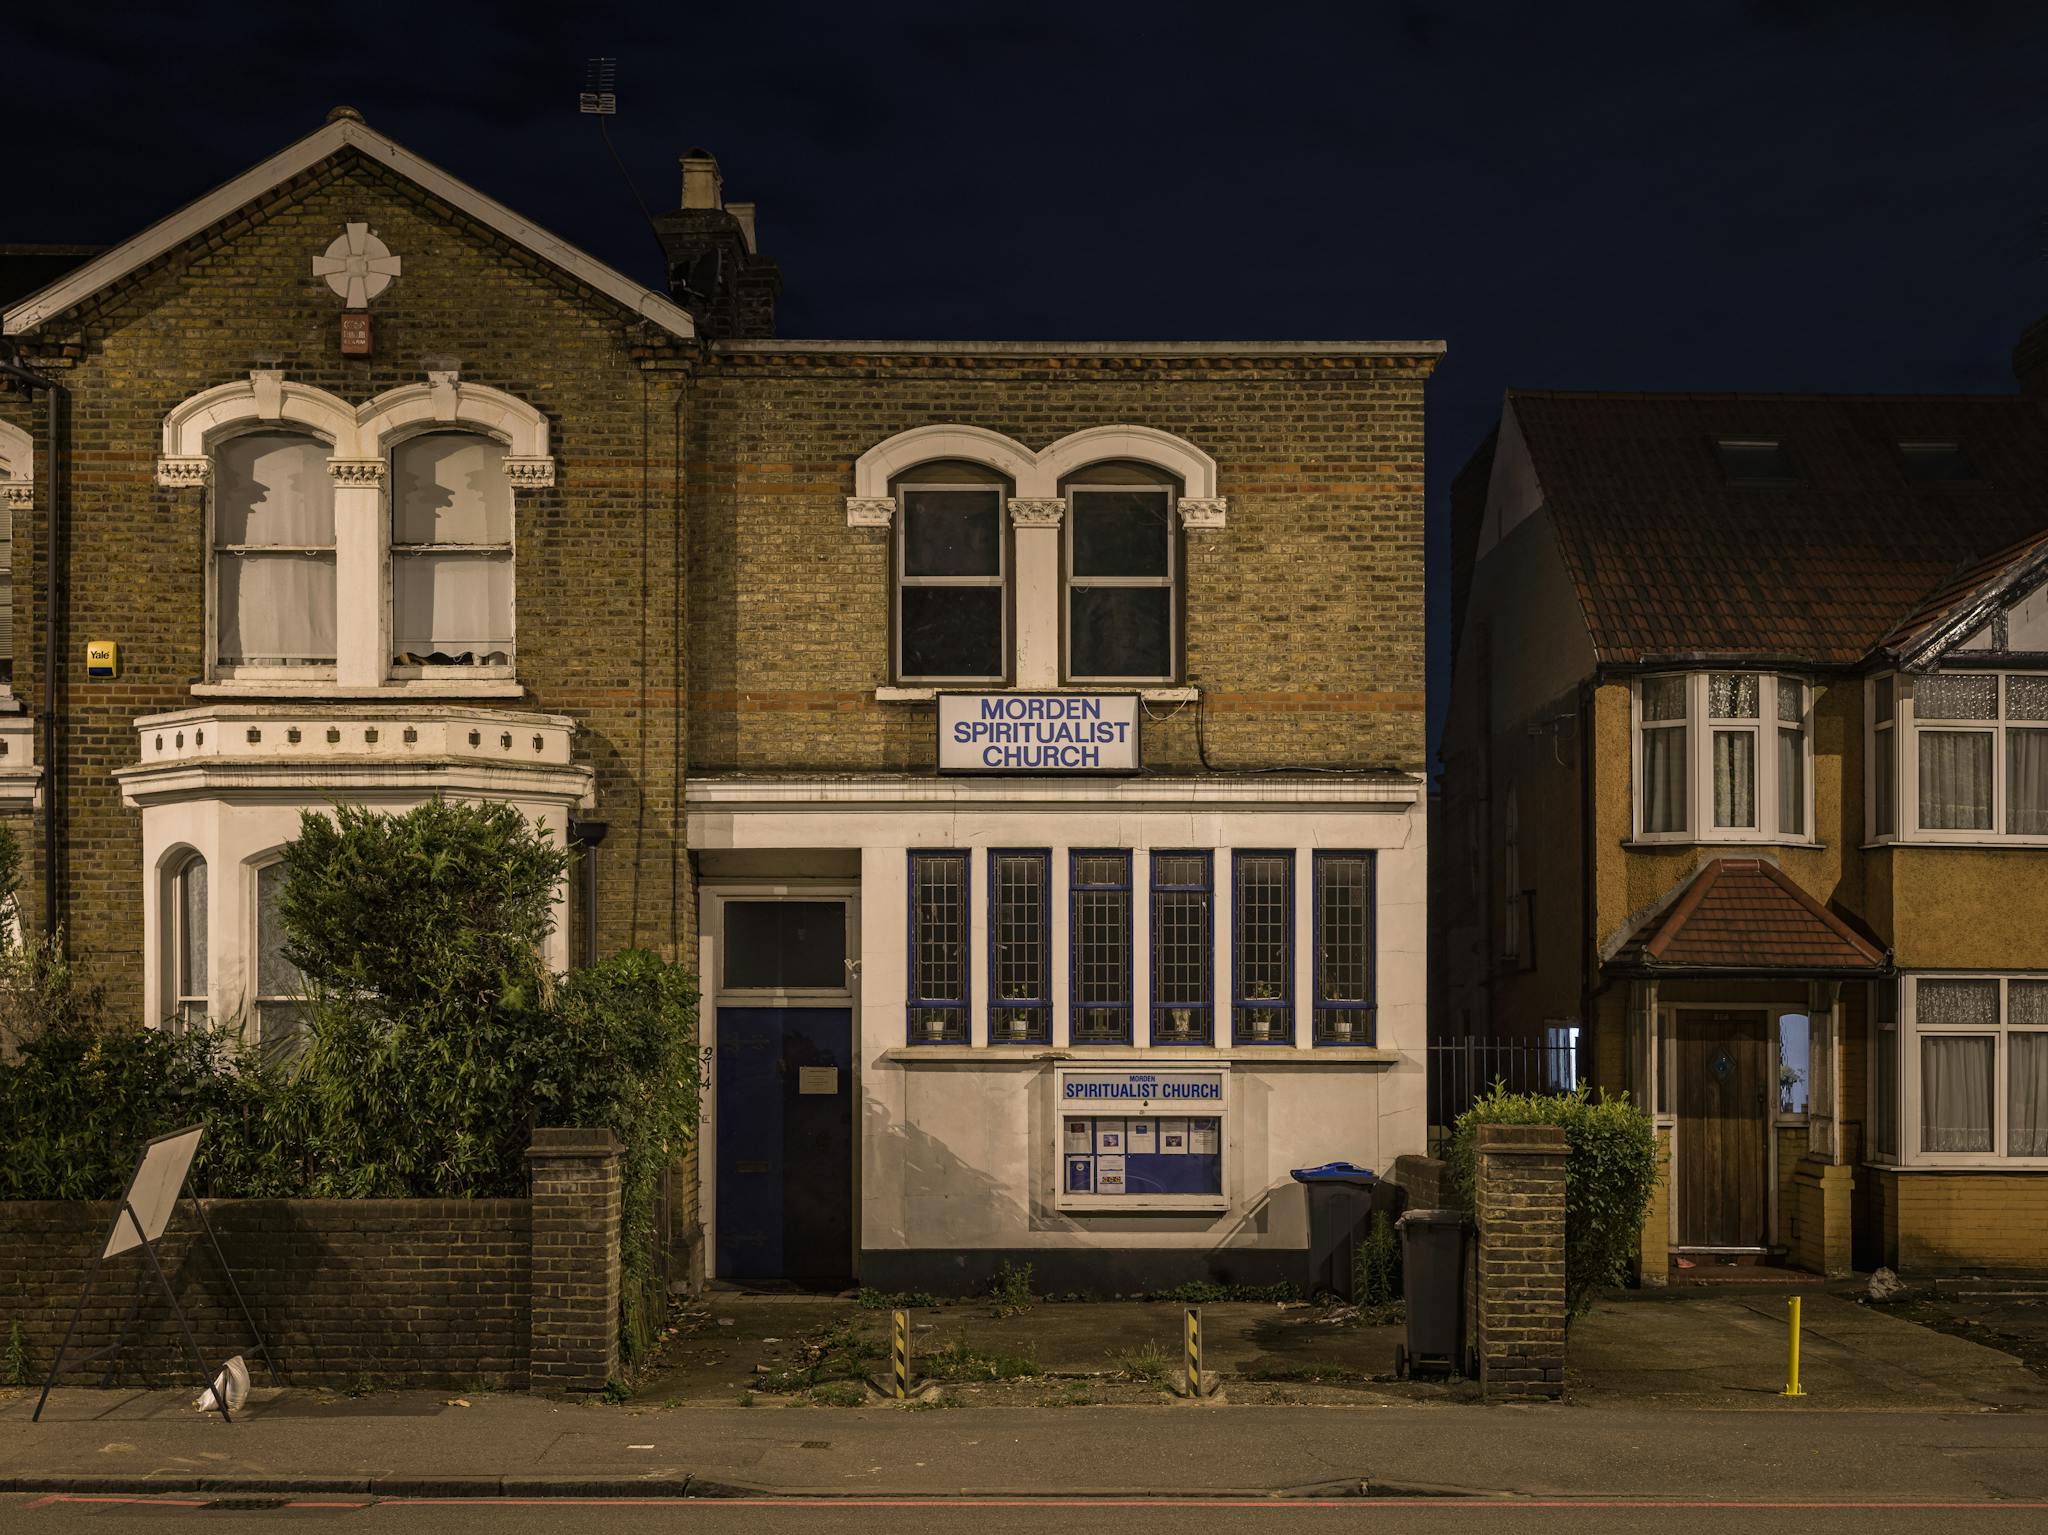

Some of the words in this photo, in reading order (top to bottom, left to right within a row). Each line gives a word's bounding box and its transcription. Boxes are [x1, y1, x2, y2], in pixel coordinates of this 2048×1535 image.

[91, 651, 109, 659] Yale
[981, 699, 1101, 720] MORDEN
[953, 721, 1130, 743] SPIRITUALIST
[982, 745, 1099, 767] CHURCH
[701, 1047, 713, 1089] 214
[1066, 1083, 1158, 1098] SPIRITUALIST
[1162, 1083, 1219, 1098] CHURCH
